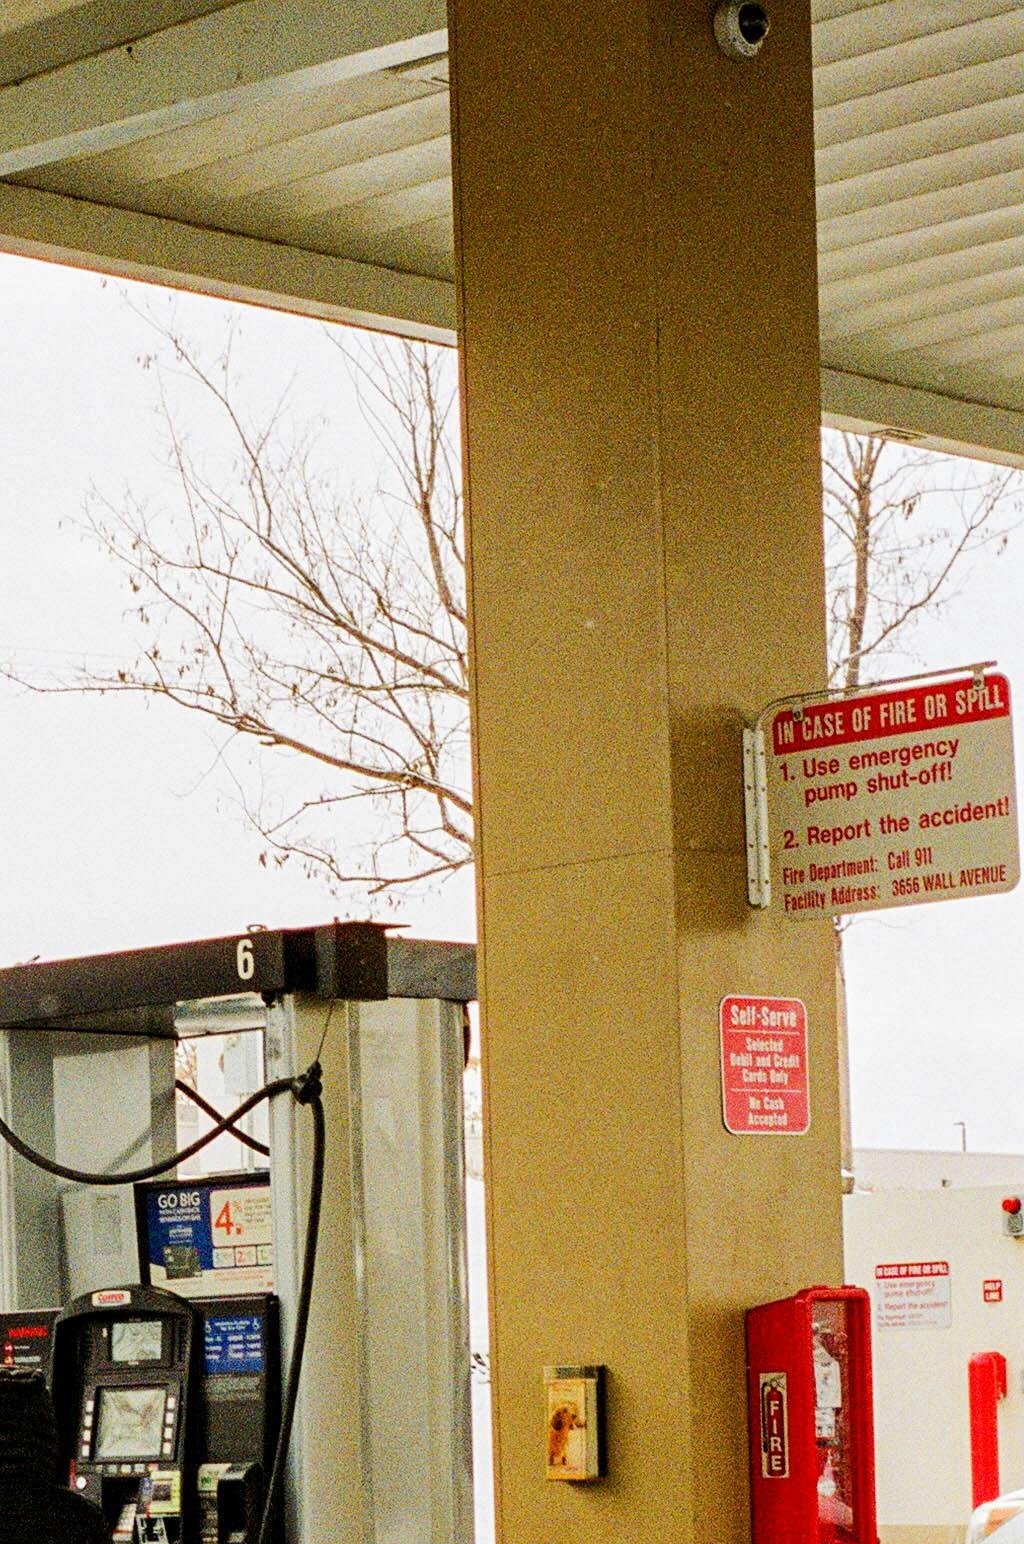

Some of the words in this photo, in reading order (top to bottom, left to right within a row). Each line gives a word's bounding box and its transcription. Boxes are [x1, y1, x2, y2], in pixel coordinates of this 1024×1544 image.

[777, 721, 794, 745] IN
[802, 711, 845, 741] CASE
[852, 706, 872, 733] OF
[880, 698, 918, 728] FIRE
[924, 692, 947, 719] OR
[956, 684, 1004, 716] SPILL
[779, 762, 795, 782] 1.
[802, 756, 840, 779] Use
[849, 738, 960, 770] emergency
[804, 777, 858, 807] pump
[867, 761, 952, 794] shut-off!
[783, 830, 799, 849] 2.
[807, 819, 871, 846] Report
[879, 814, 910, 835] the
[919, 796, 1010, 829] accident!
[783, 867, 805, 885] Fire
[809, 857, 878, 883] Department:
[888, 849, 910, 871] Call
[914, 847, 932, 865] 911
[784, 890, 826, 912] Facility
[831, 886, 880, 906] Address:
[892, 877, 920, 897] 3656
[923, 872, 956, 892] WALL
[959, 864, 1007, 888] AVENUE
[237, 939, 255, 980] 6
[730, 1005, 797, 1027] Self-Serve
[158, 1194, 178, 1209] GO
[180, 1192, 201, 1207] BIG
[770, 1400, 783, 1471] FIRE
